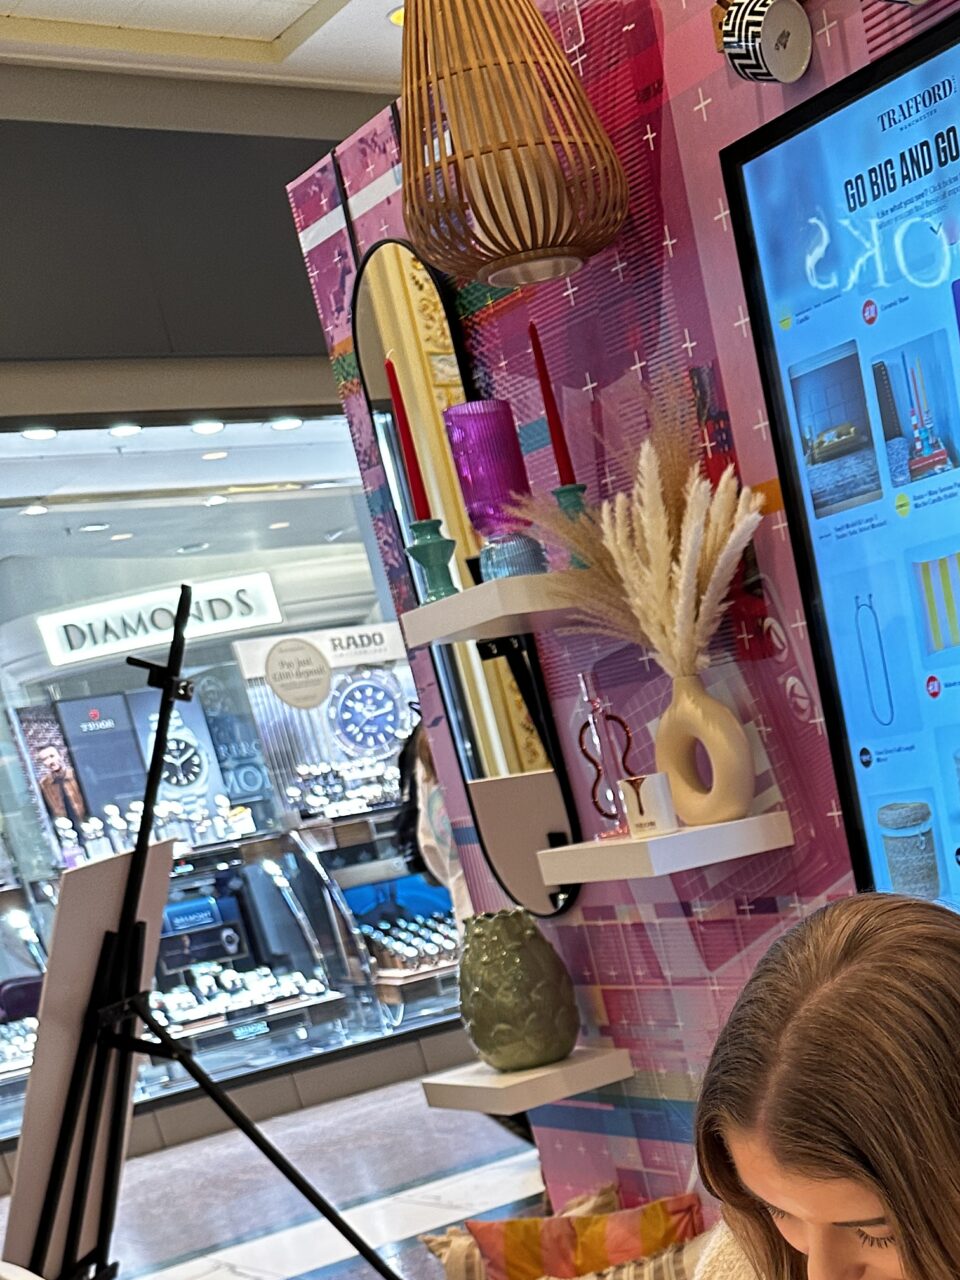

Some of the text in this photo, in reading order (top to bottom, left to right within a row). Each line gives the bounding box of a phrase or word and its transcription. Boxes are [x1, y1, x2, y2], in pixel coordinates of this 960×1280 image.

[877, 78, 954, 132] TRAFFORD
[844, 174, 867, 213] GO
[867, 158, 897, 202] BIG
[899, 140, 933, 187] AND
[934, 126, 960, 168] GO
[63, 588, 254, 651] DIAMONDS
[330, 632, 385, 652] RADO
